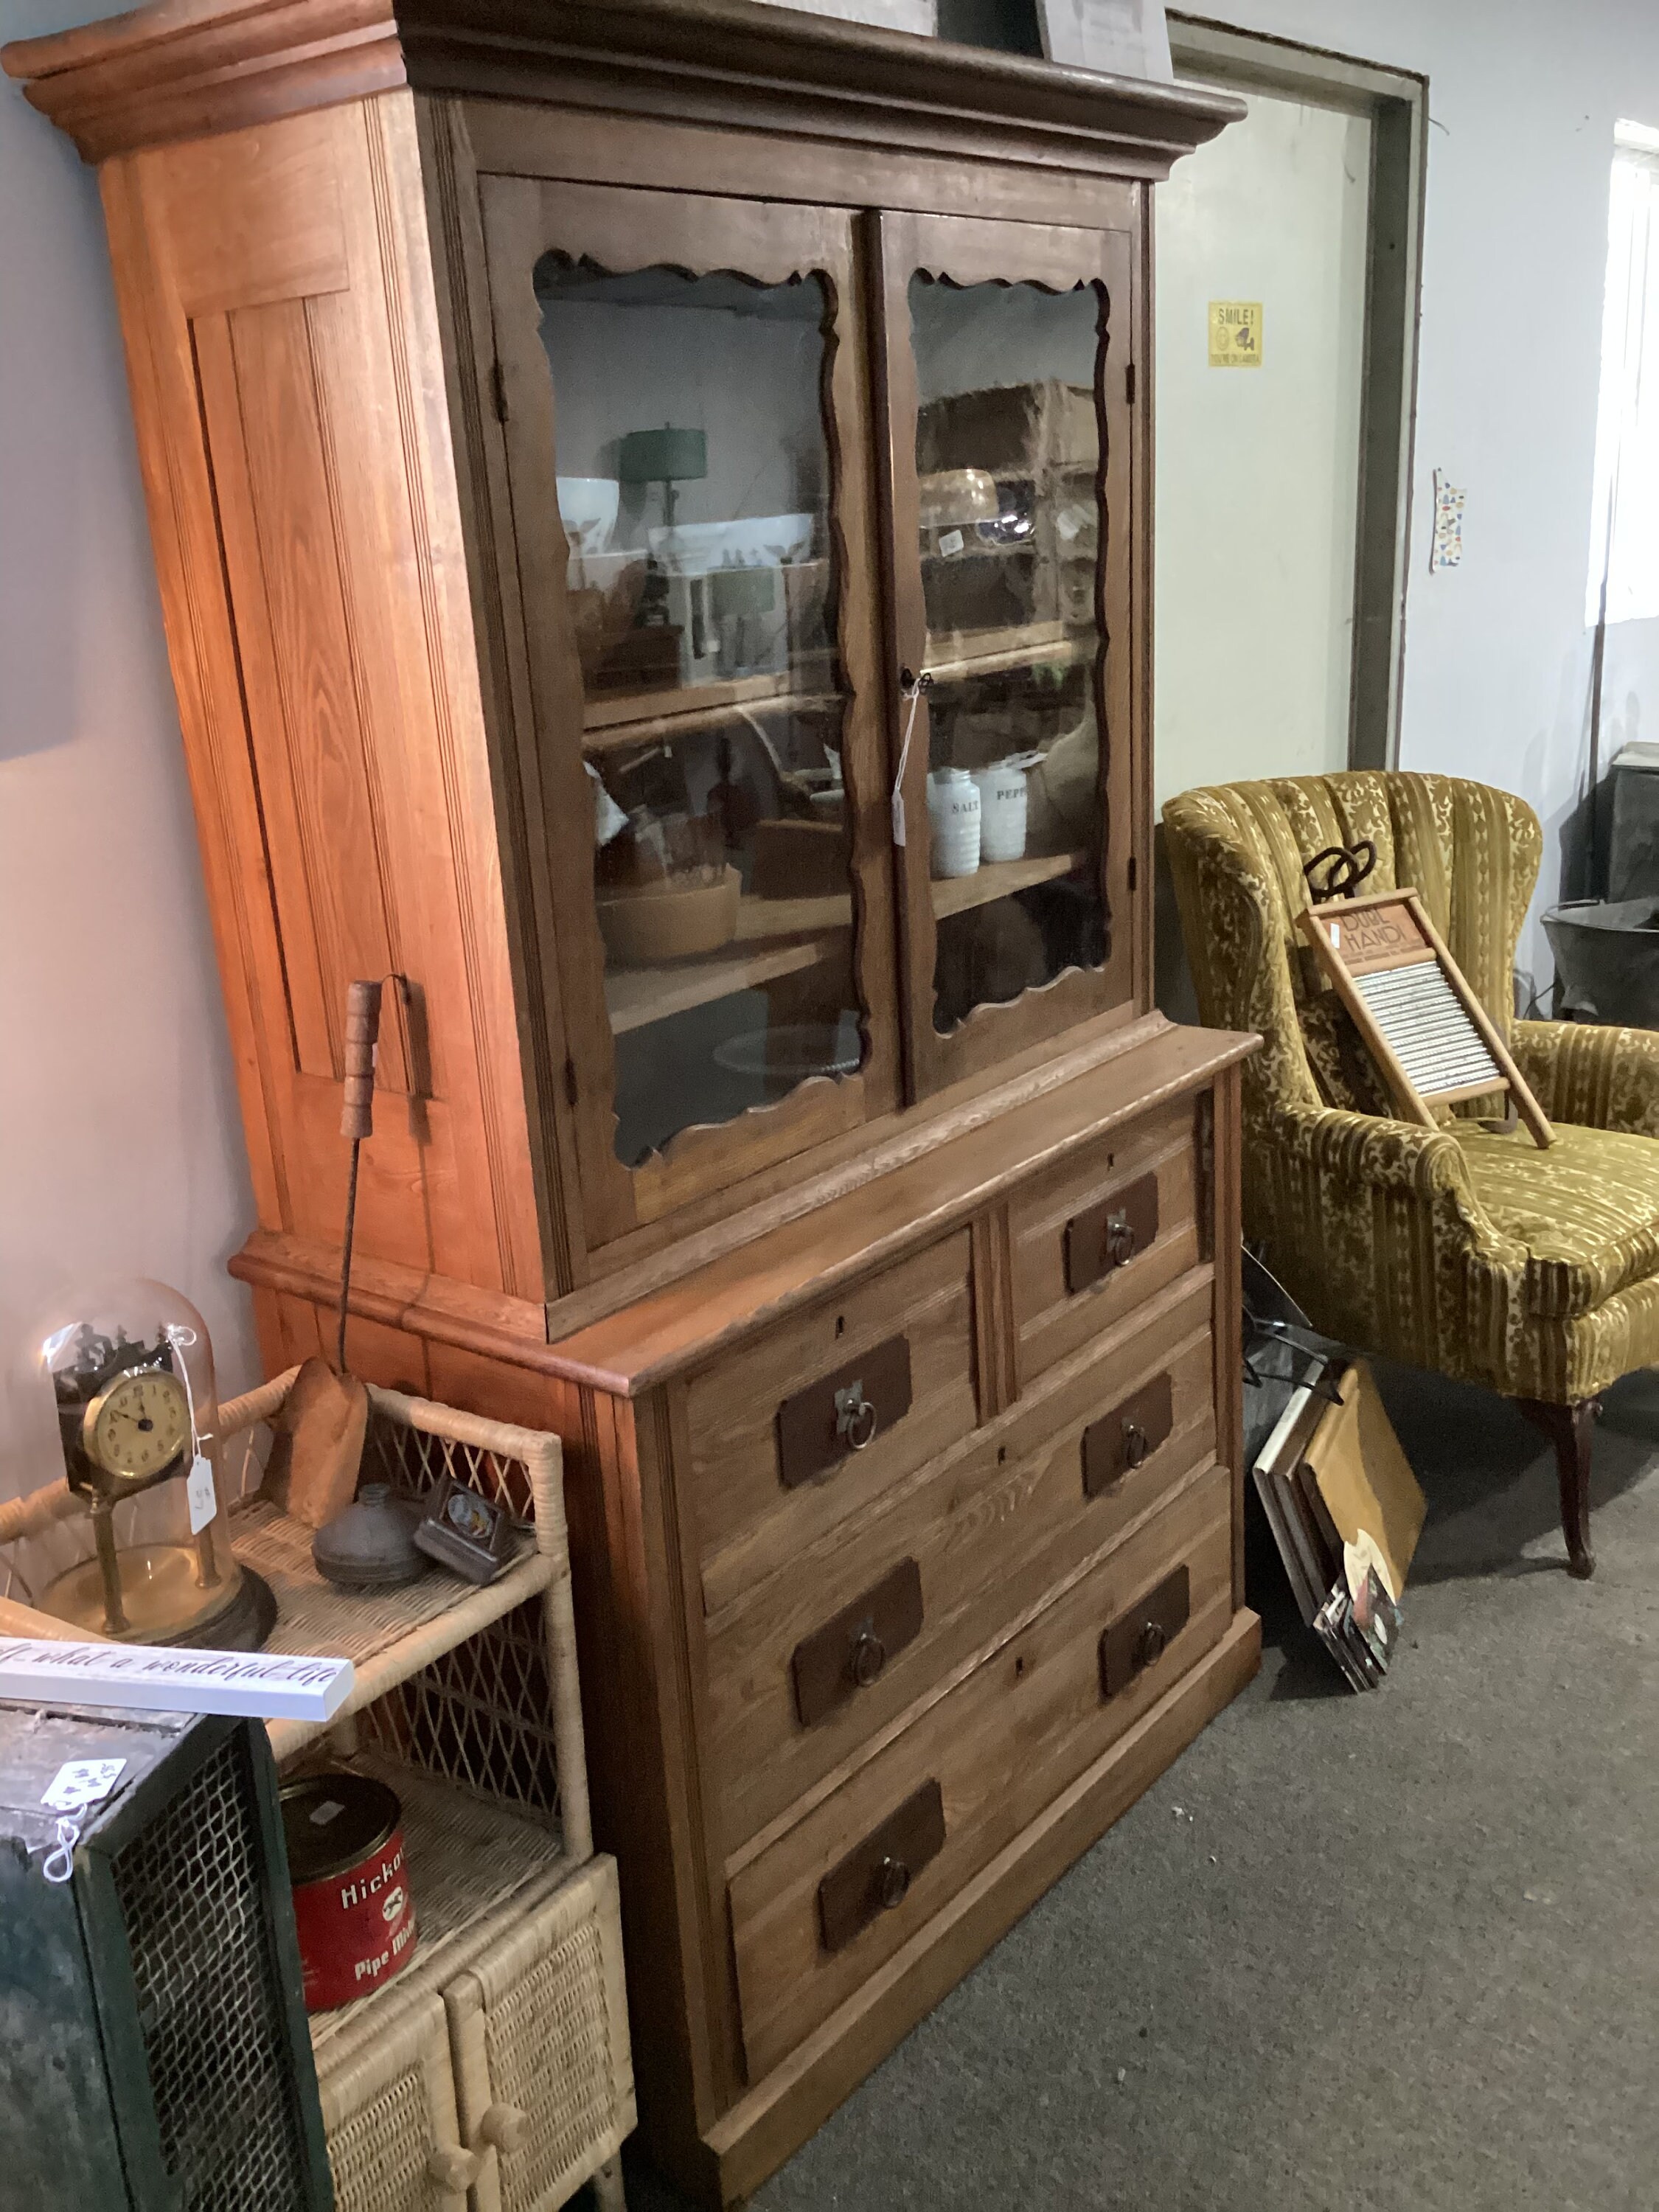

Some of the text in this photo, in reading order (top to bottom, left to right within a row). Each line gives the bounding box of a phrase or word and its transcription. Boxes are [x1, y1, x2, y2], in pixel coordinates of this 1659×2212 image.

[1219, 307, 1253, 325] SMILE!
[951, 800, 978, 813] SALT
[1343, 925, 1408, 952] HANDI
[32, 1646, 116, 1666] what
[110, 1658, 133, 1668] a
[142, 1656, 294, 1681] wonderful
[287, 1662, 337, 1686] life
[355, 1951, 389, 1981] Pipe
